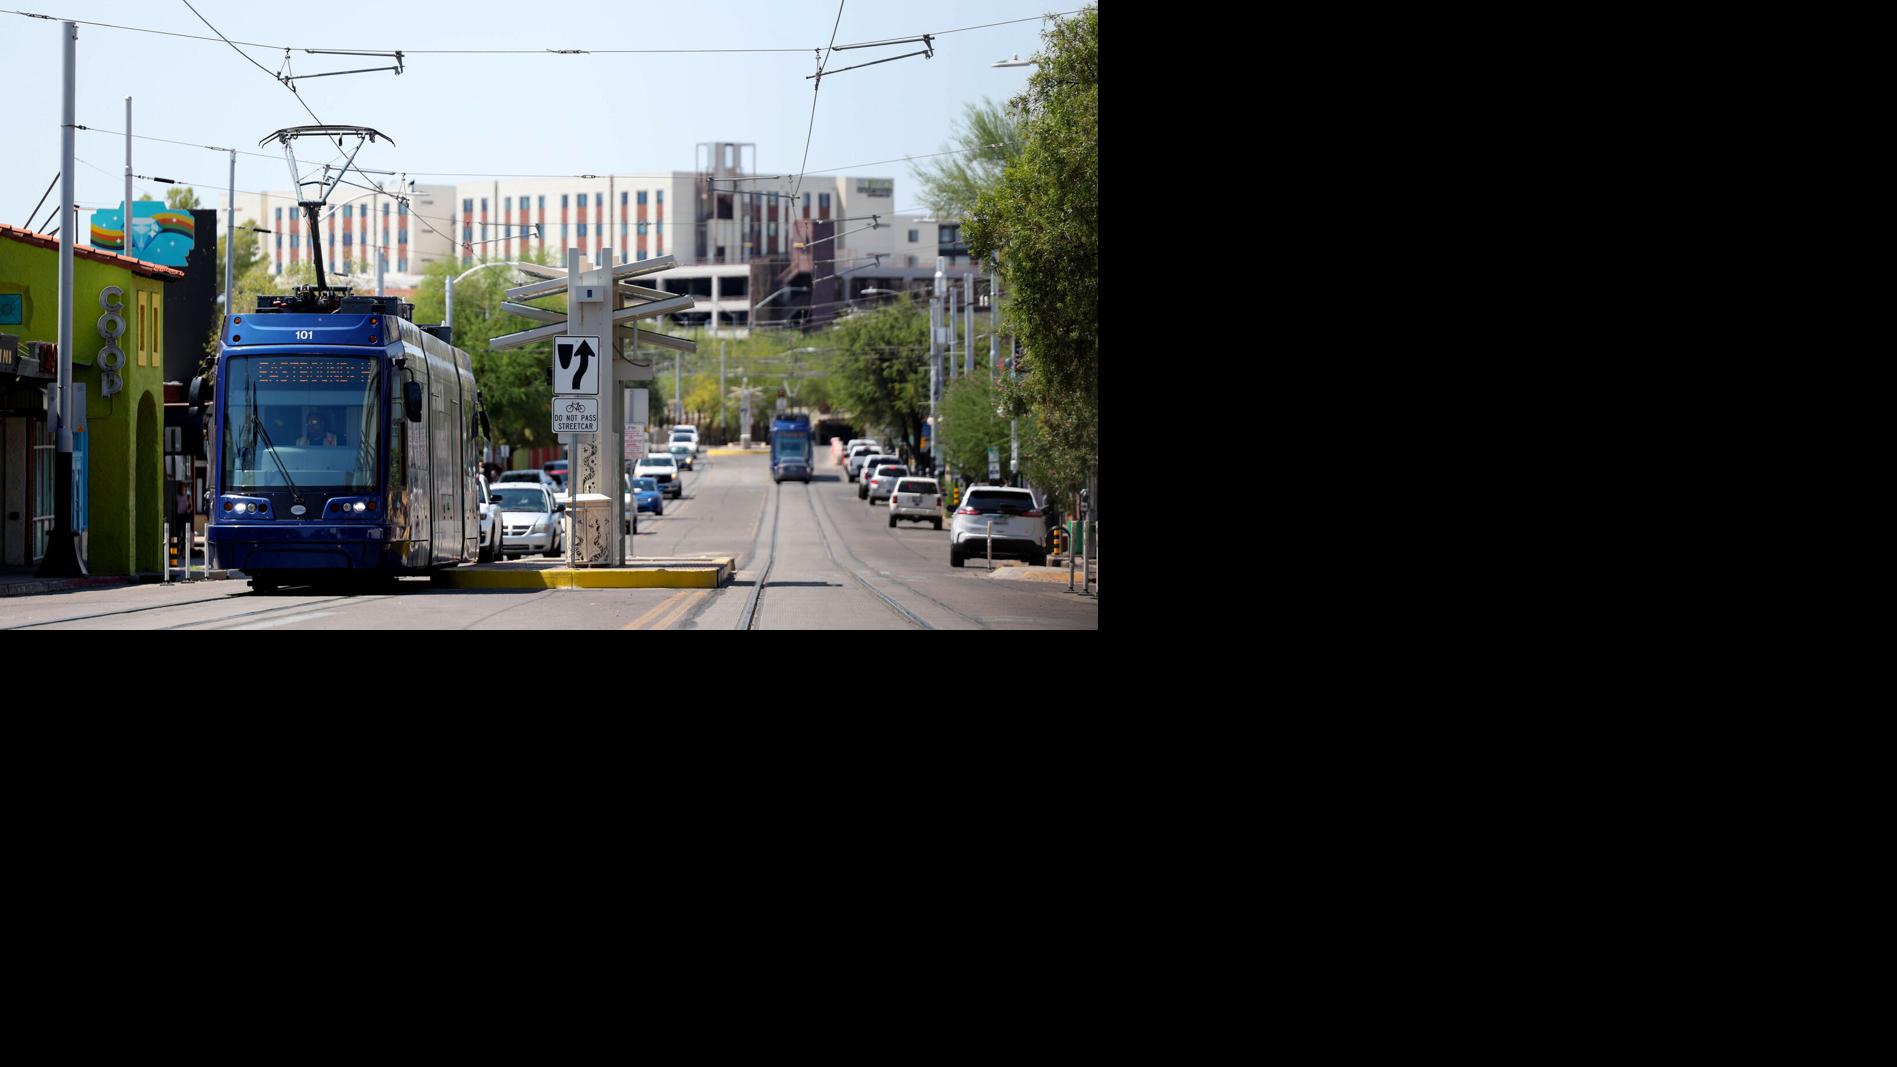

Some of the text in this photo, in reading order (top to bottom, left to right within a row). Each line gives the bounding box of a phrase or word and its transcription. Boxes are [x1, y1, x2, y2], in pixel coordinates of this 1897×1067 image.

[295, 330, 313, 340] 101
[554, 414, 597, 422] DO NOT PASS
[558, 422, 594, 430] STREETCAR
